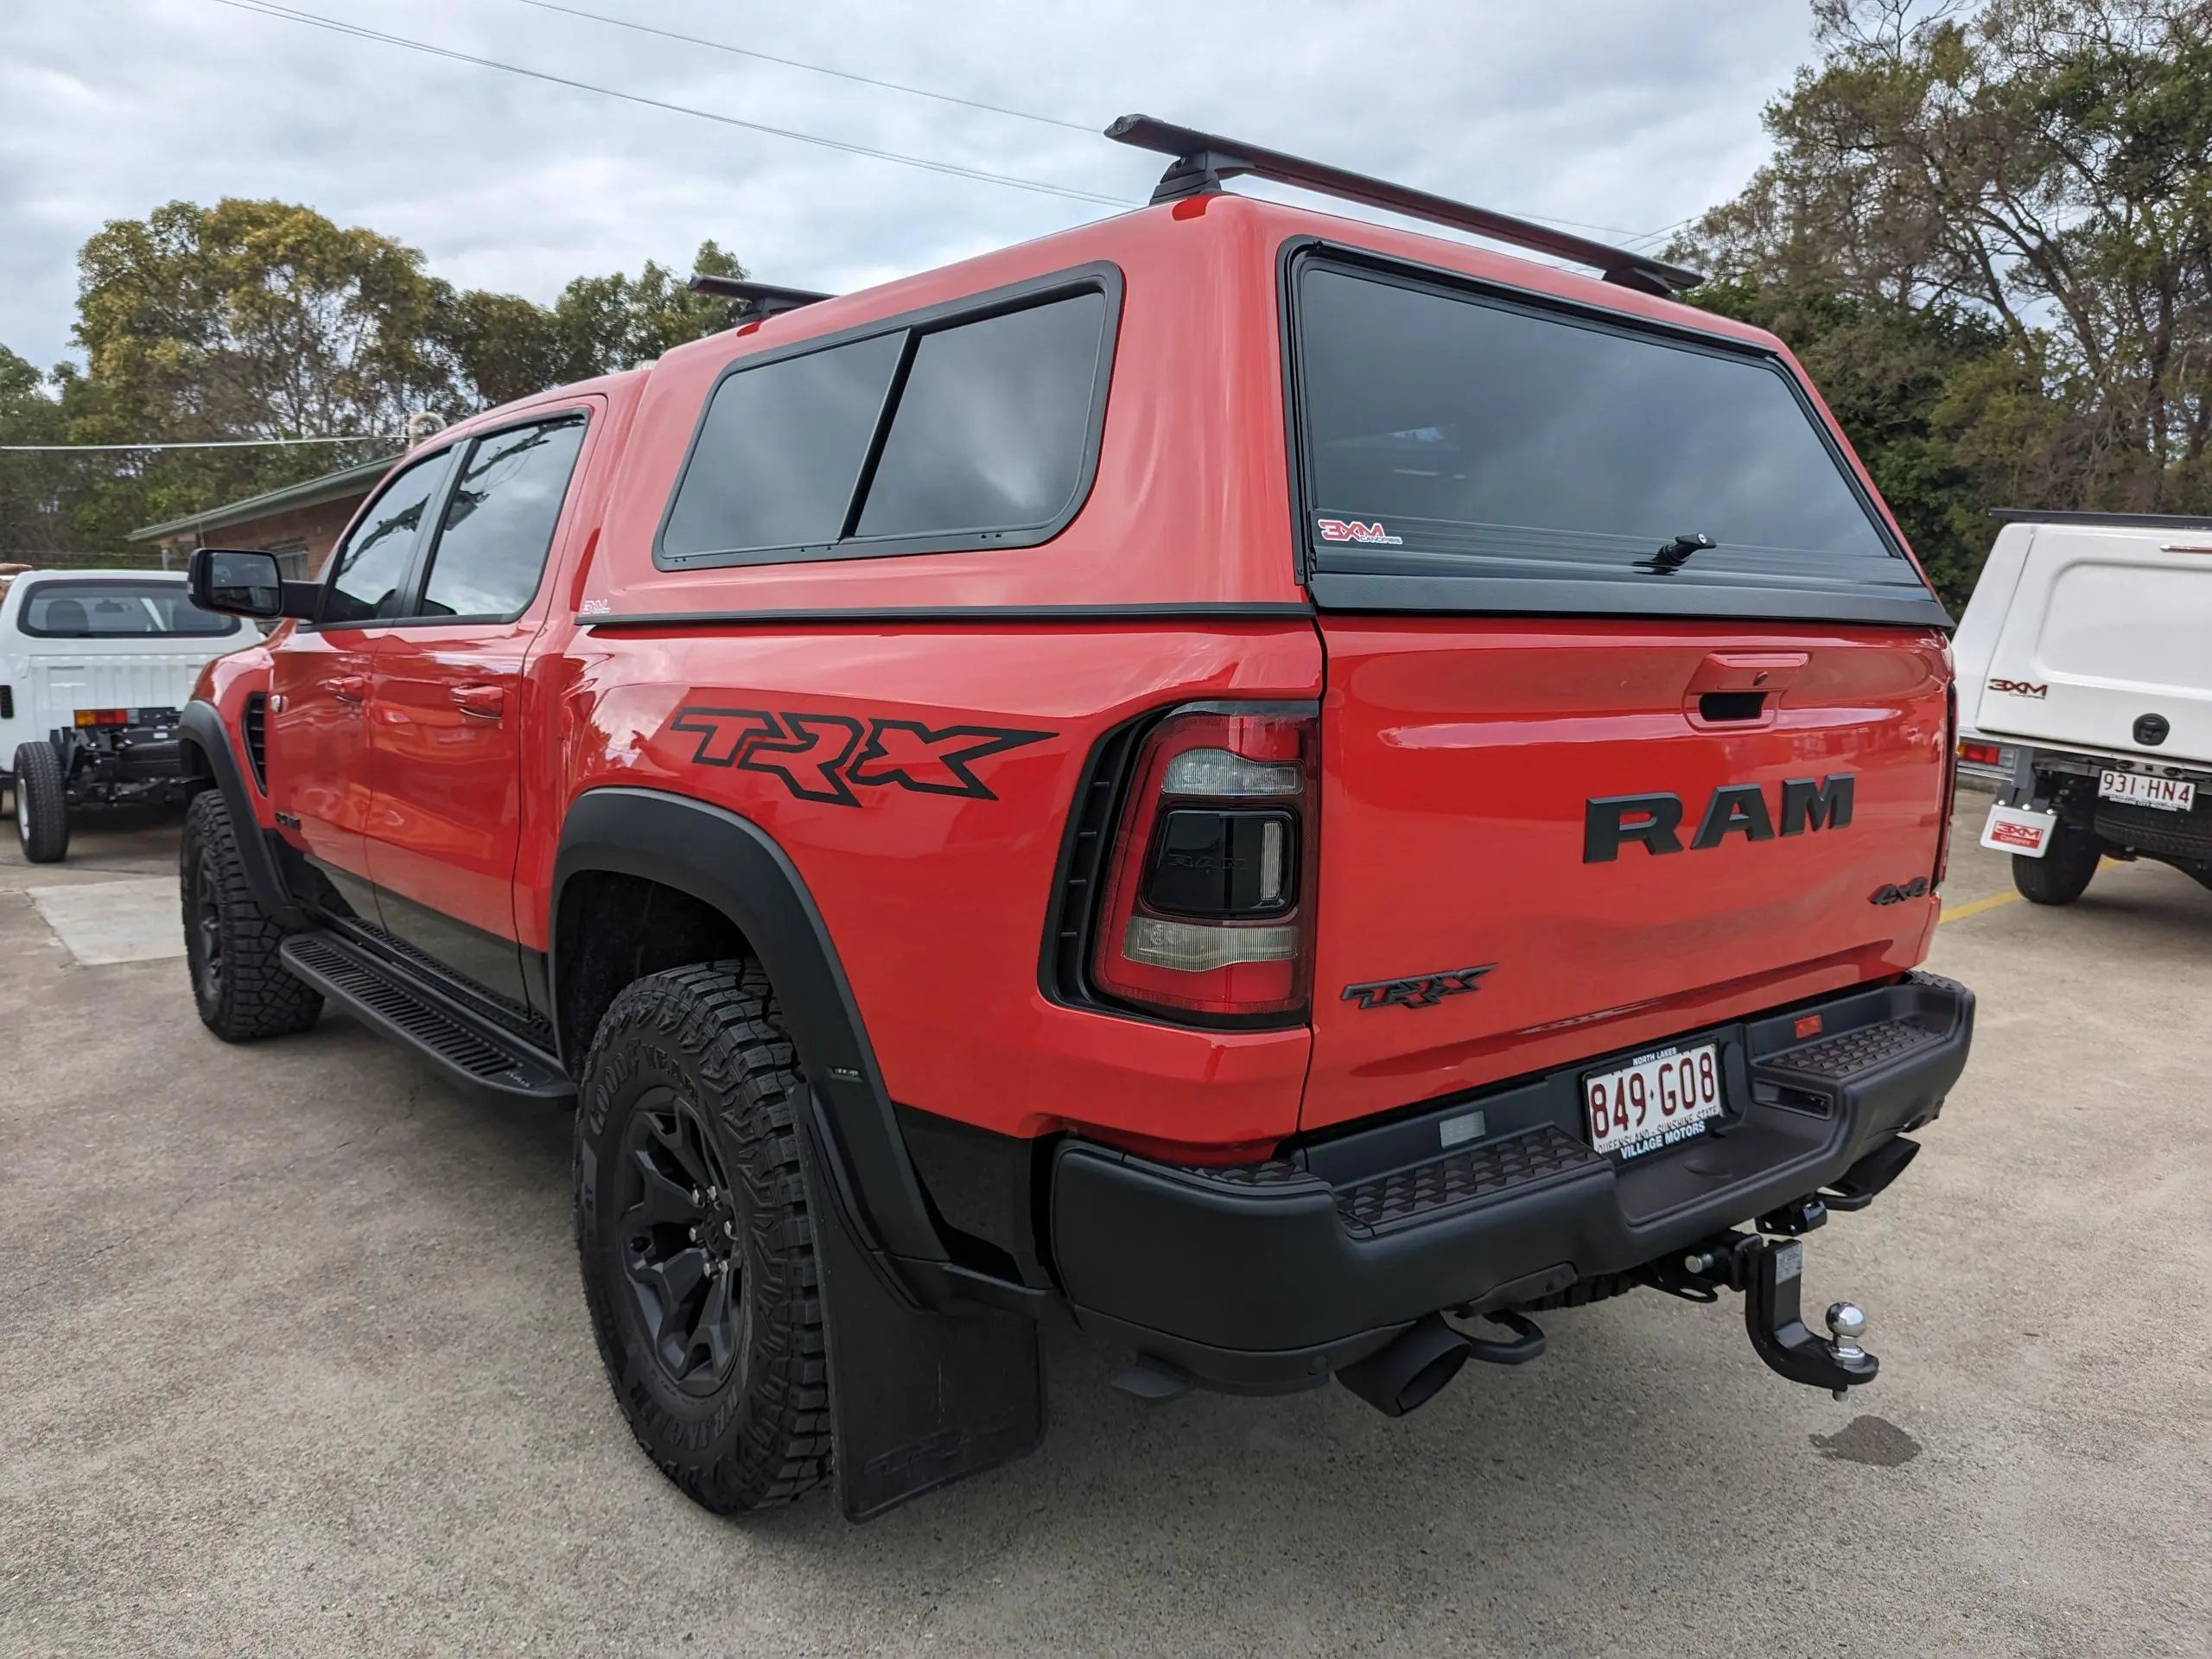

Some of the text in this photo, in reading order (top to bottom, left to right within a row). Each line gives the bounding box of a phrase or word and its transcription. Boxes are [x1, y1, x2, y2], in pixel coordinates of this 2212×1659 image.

[1318, 519, 1385, 542] 3XM
[1988, 678, 2048, 697] 3XM
[670, 707, 1060, 808] TRX
[1582, 772, 1855, 865] RAM
[1341, 963, 1499, 1009] TRX
[1632, 1046, 1678, 1066] NORTH LAKES
[1620, 1121, 1706, 1160] VILLAGE MOTORS
